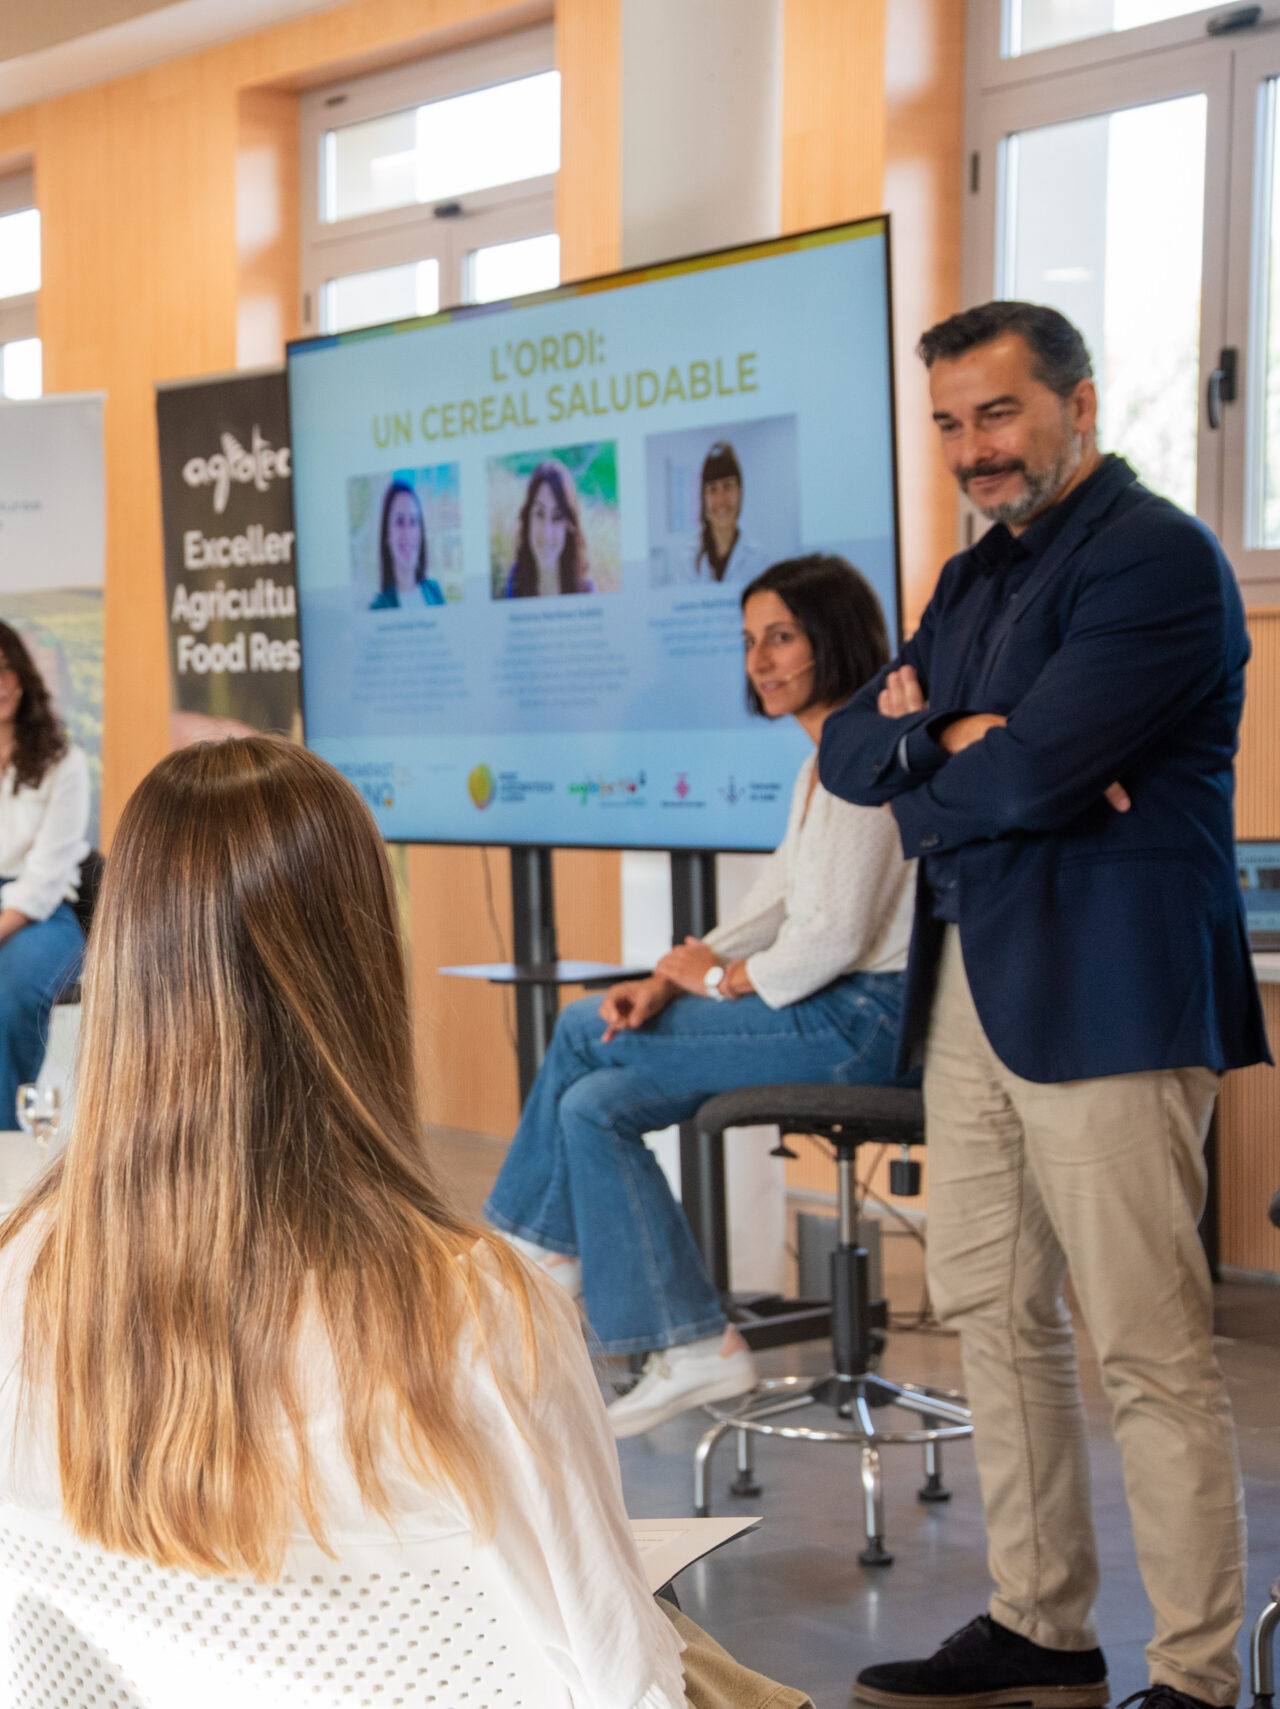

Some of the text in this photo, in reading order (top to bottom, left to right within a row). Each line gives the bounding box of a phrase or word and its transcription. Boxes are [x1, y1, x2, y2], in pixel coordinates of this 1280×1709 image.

[372, 352, 759, 449] UN CEREAL SALUDABLE
[177, 631, 247, 675] Food
